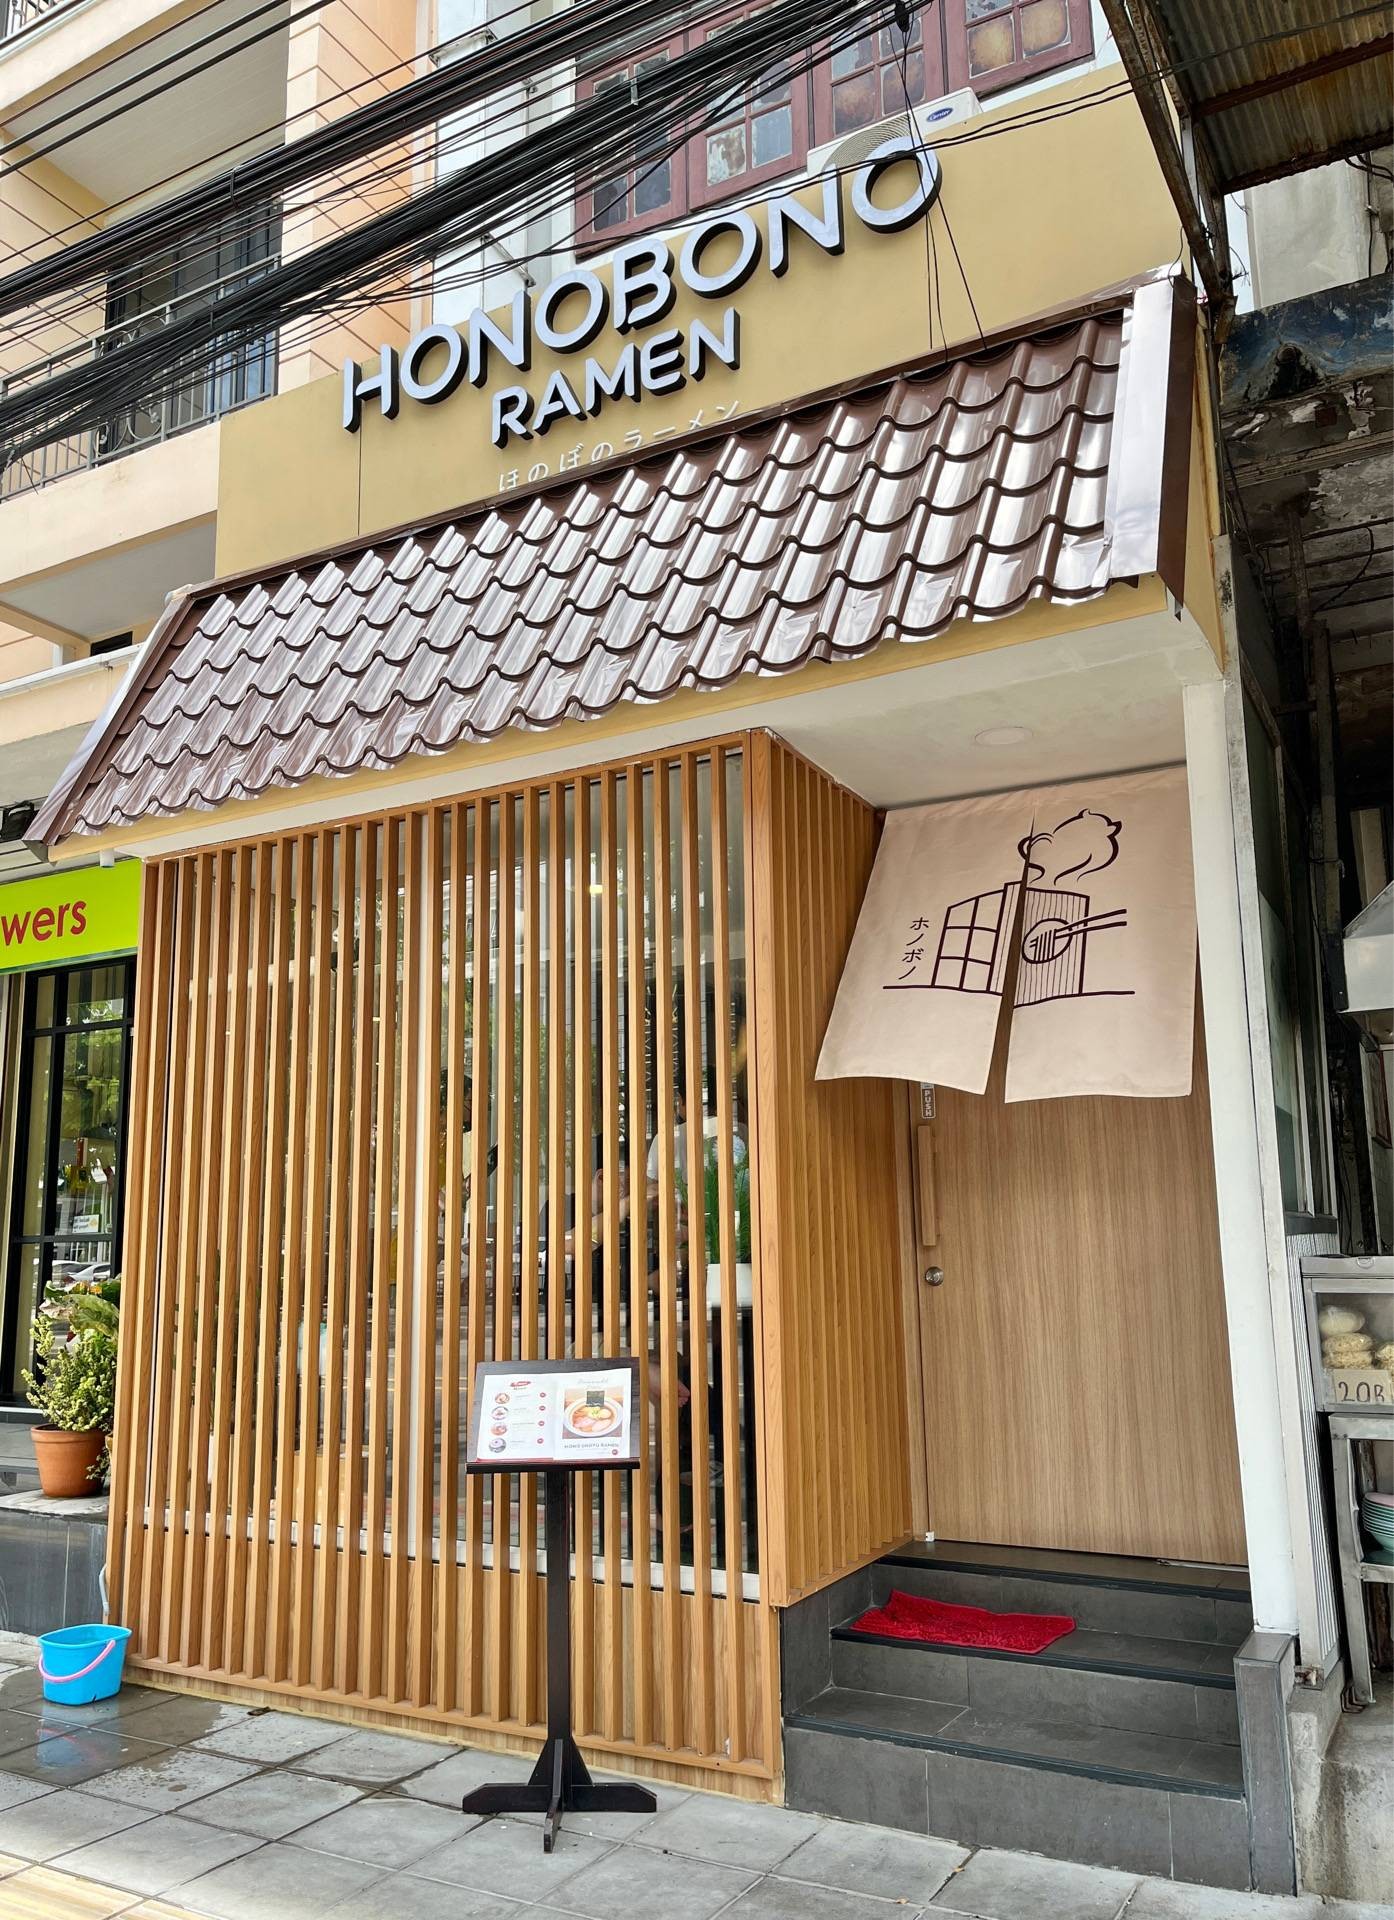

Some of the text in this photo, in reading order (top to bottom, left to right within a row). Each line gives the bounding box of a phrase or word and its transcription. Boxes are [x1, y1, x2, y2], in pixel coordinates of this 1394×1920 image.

[342, 135, 941, 433] HONOBONO
[492, 308, 741, 448] RAMEN
[499, 400, 740, 492] ほのぼのラーメン
[0, 900, 87, 946] wers
[898, 916, 929, 980] ホノボノ
[924, 1089, 932, 1116] PUSH
